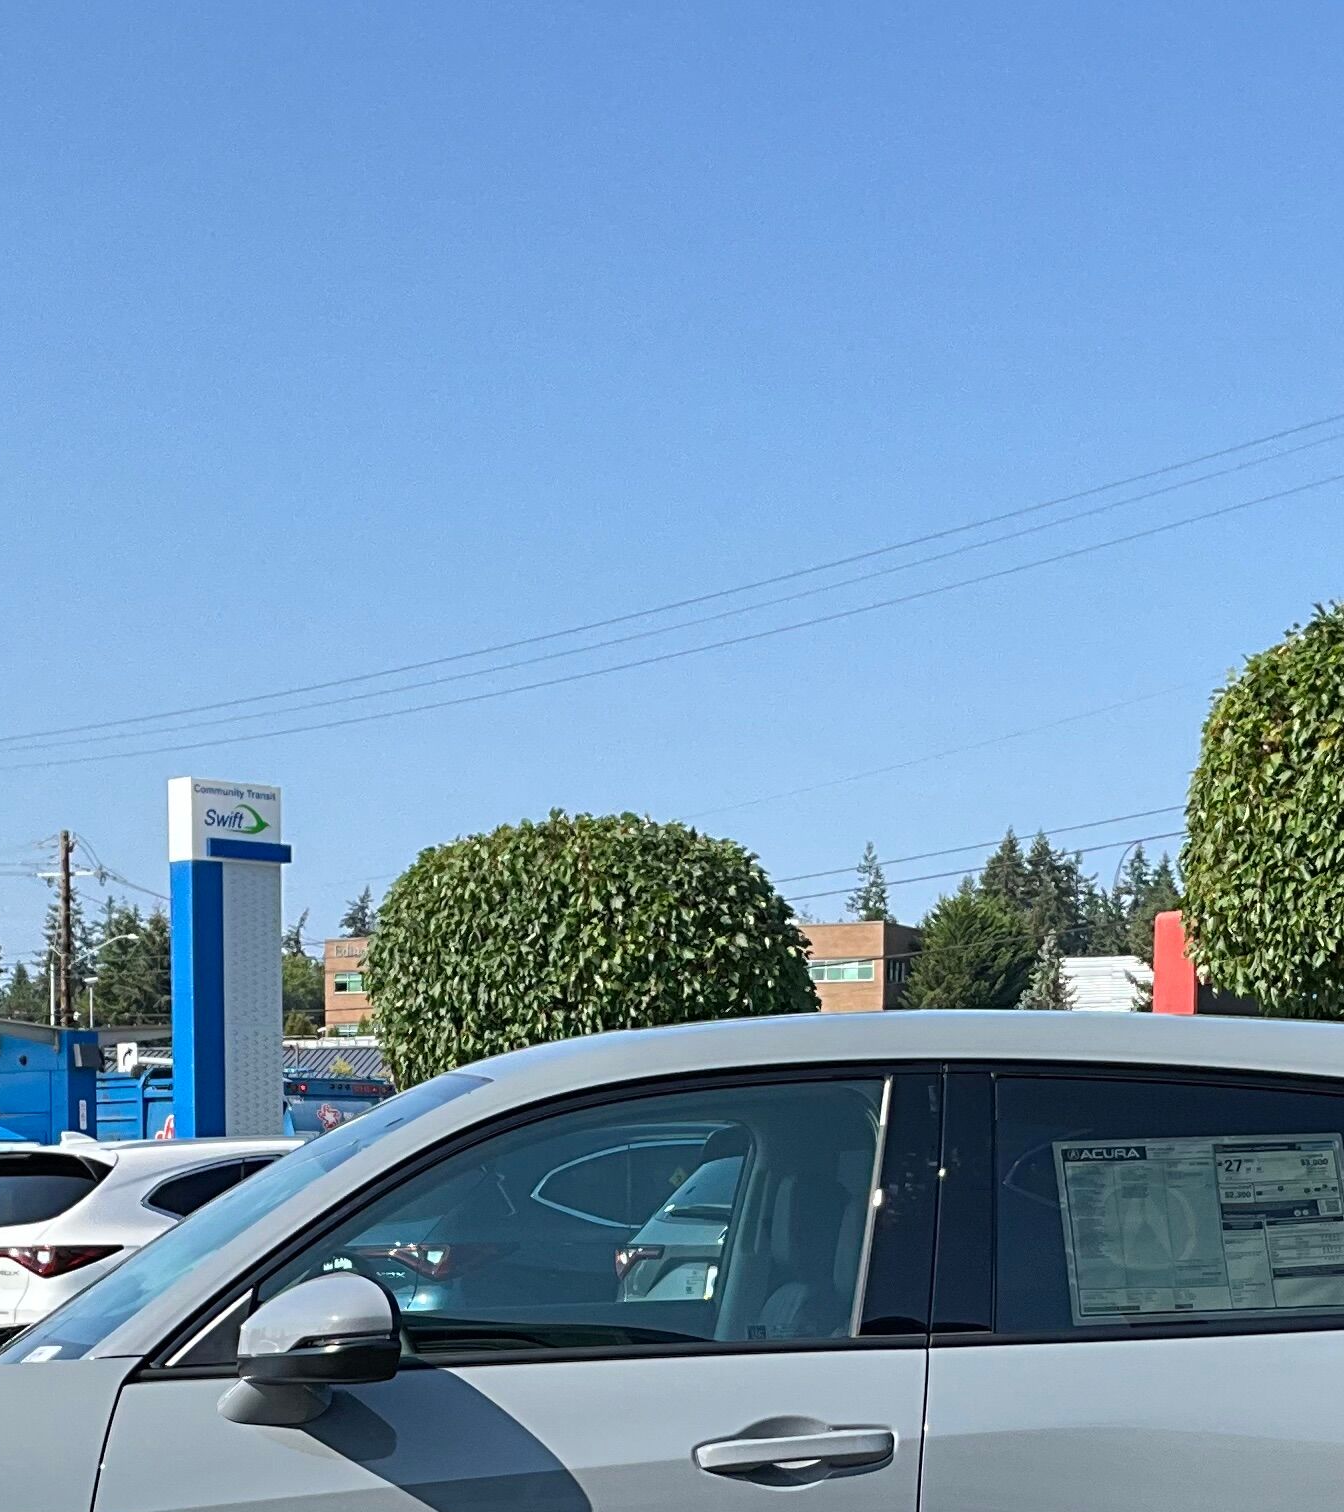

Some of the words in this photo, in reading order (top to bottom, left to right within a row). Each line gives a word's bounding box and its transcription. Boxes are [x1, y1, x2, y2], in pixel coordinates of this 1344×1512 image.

[194, 784, 244, 799] Community
[247, 790, 276, 800] Transit
[204, 808, 244, 828] Swift
[1080, 1148, 1140, 1160] ACURA
[1224, 1159, 1242, 1172] 27
